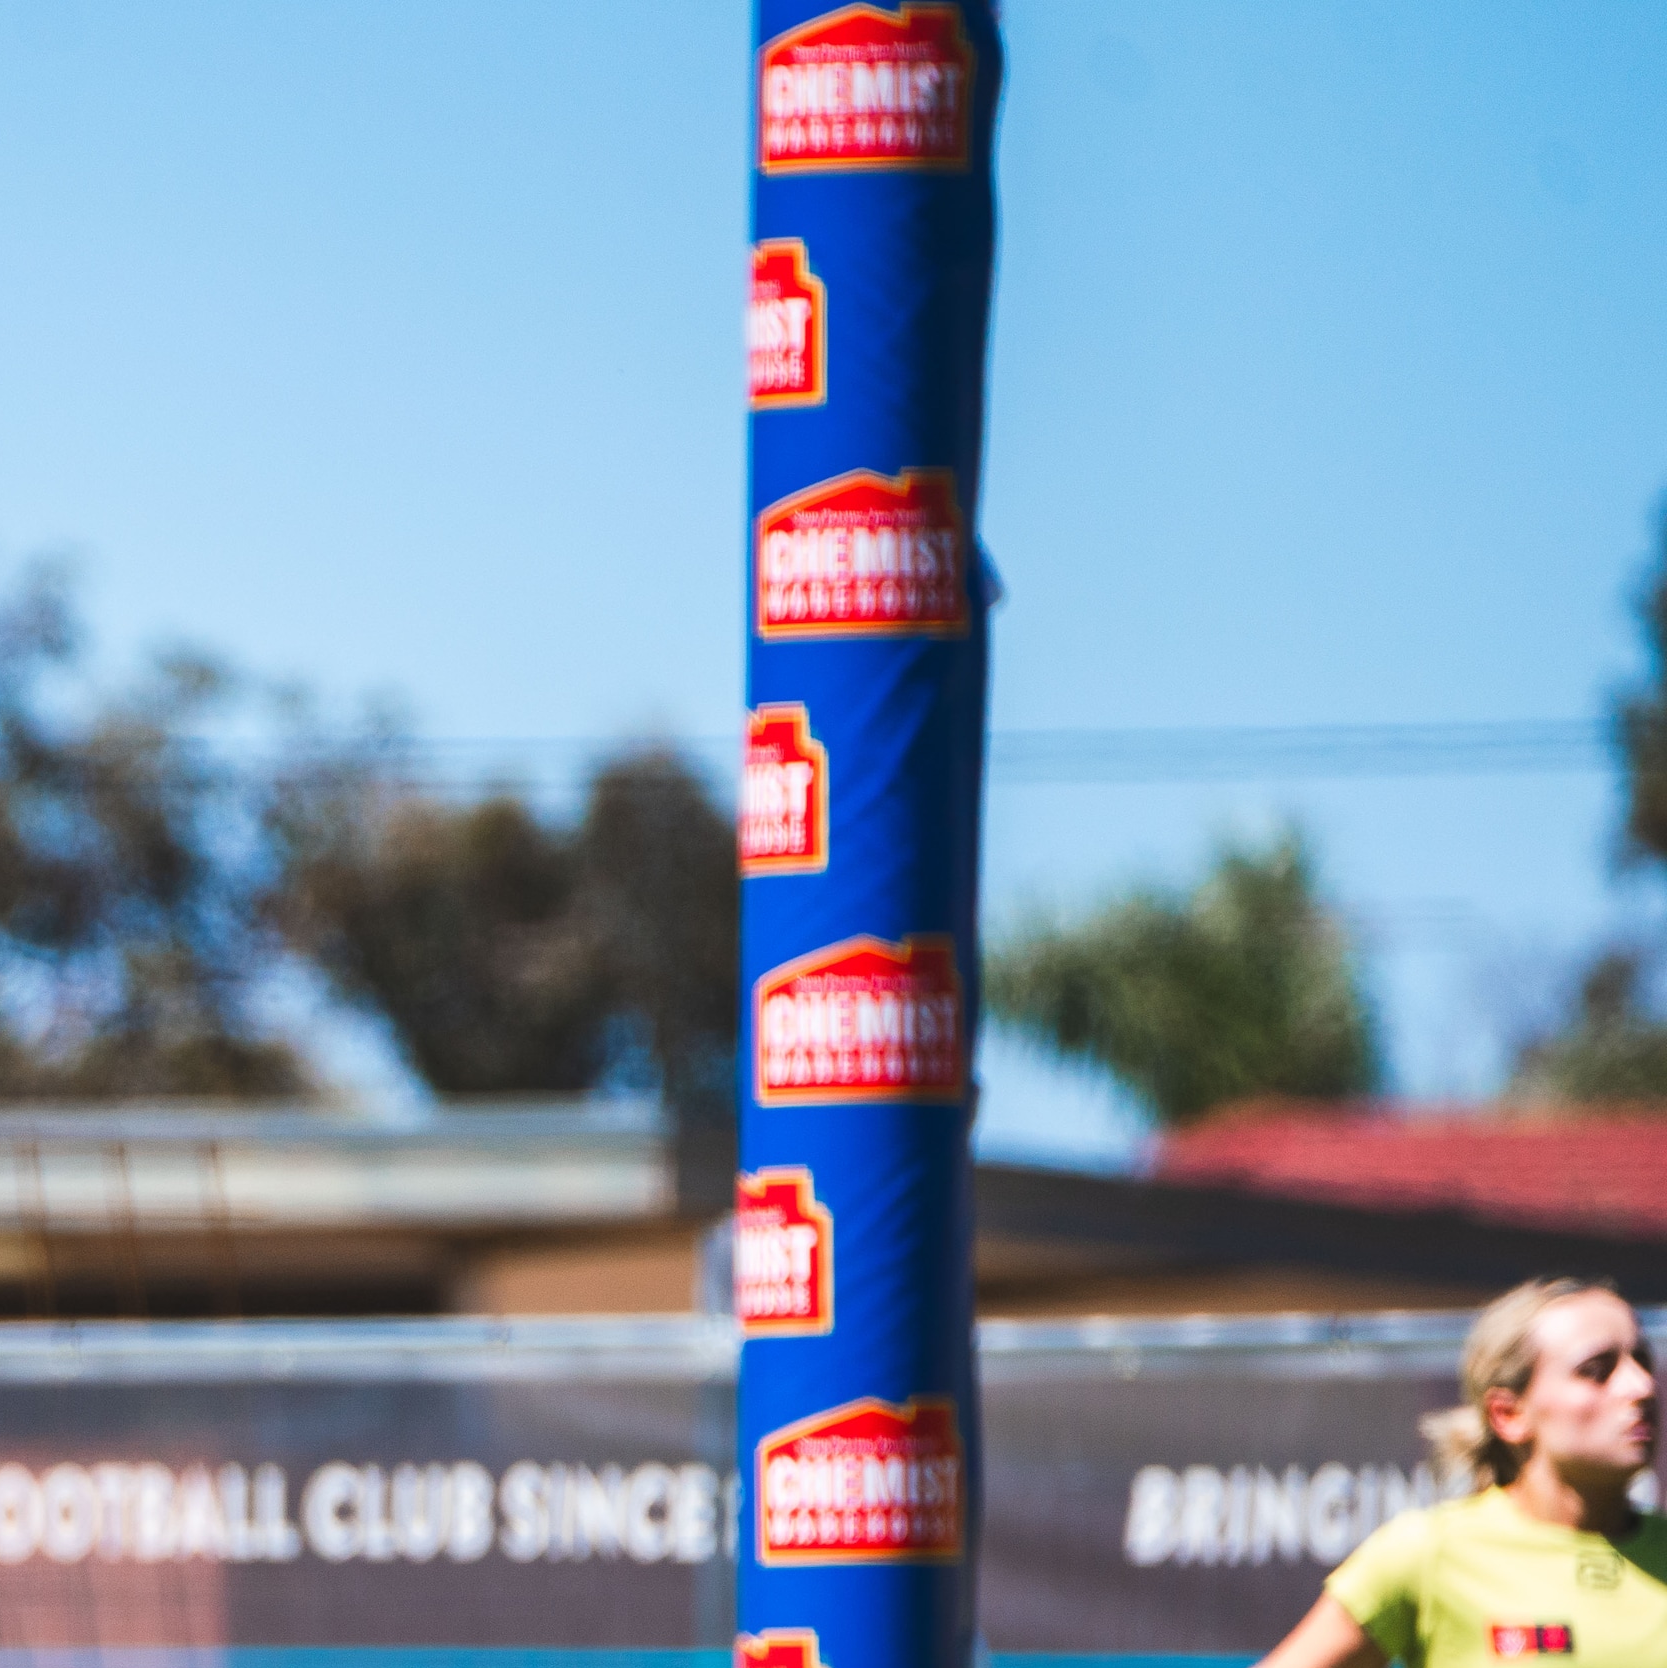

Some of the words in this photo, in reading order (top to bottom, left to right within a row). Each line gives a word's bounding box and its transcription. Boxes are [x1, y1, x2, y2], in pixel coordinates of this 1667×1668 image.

[767, 62, 959, 119] CHEMIST
[767, 527, 955, 585] CHEMIST
[767, 992, 957, 1050] CHEMIST
[767, 1455, 959, 1510] CHEMIST
[302, 1460, 494, 1564] CLUB
[498, 1460, 718, 1564] SINCE
